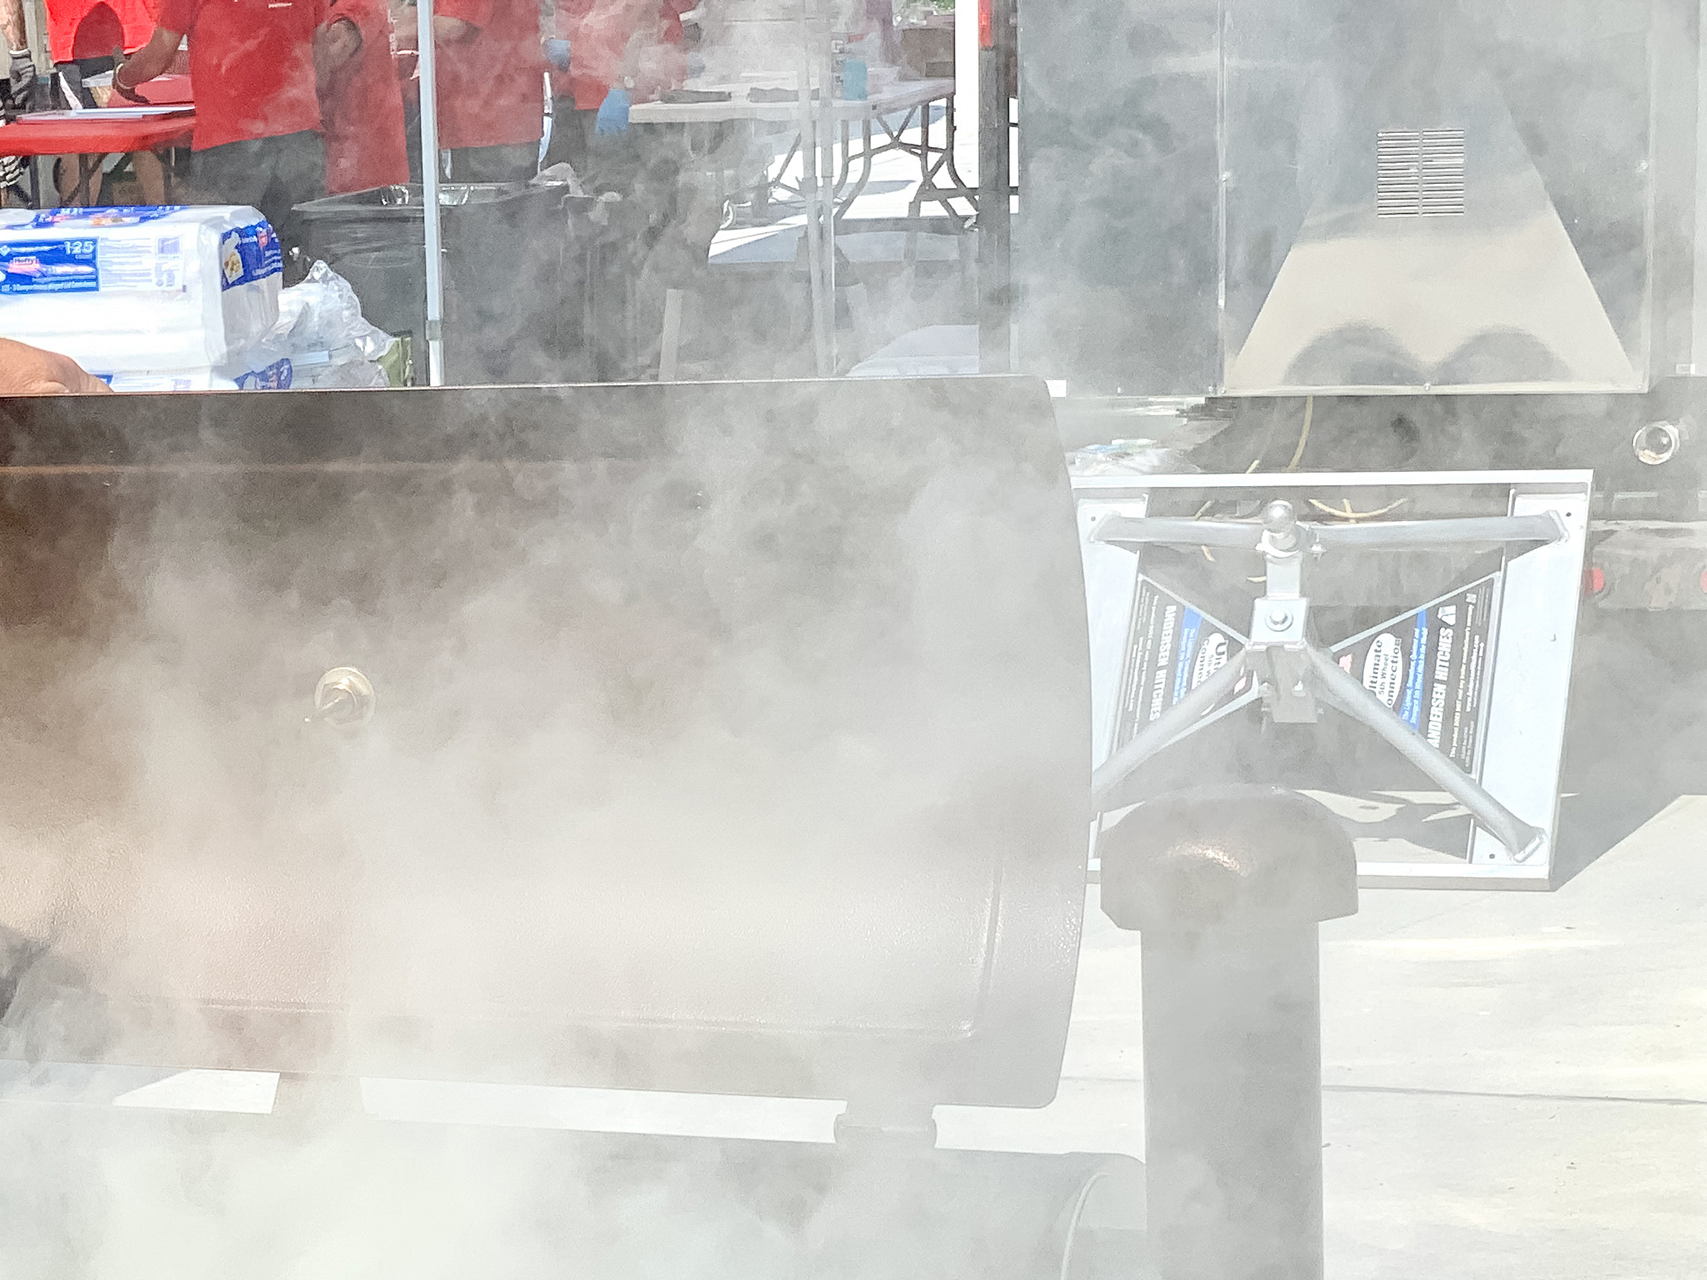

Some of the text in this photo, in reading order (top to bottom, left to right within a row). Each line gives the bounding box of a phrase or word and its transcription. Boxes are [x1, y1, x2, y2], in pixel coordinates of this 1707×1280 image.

[64, 241, 95, 255] 125
[1150, 605, 1177, 721] ANDERSEN HITCHES
[1368, 640, 1382, 689] ltimate
[1378, 653, 1389, 696] 5th Wheel
[1386, 639, 1400, 706] onnection
[1427, 627, 1453, 748] ANDERSEN HITCHES
